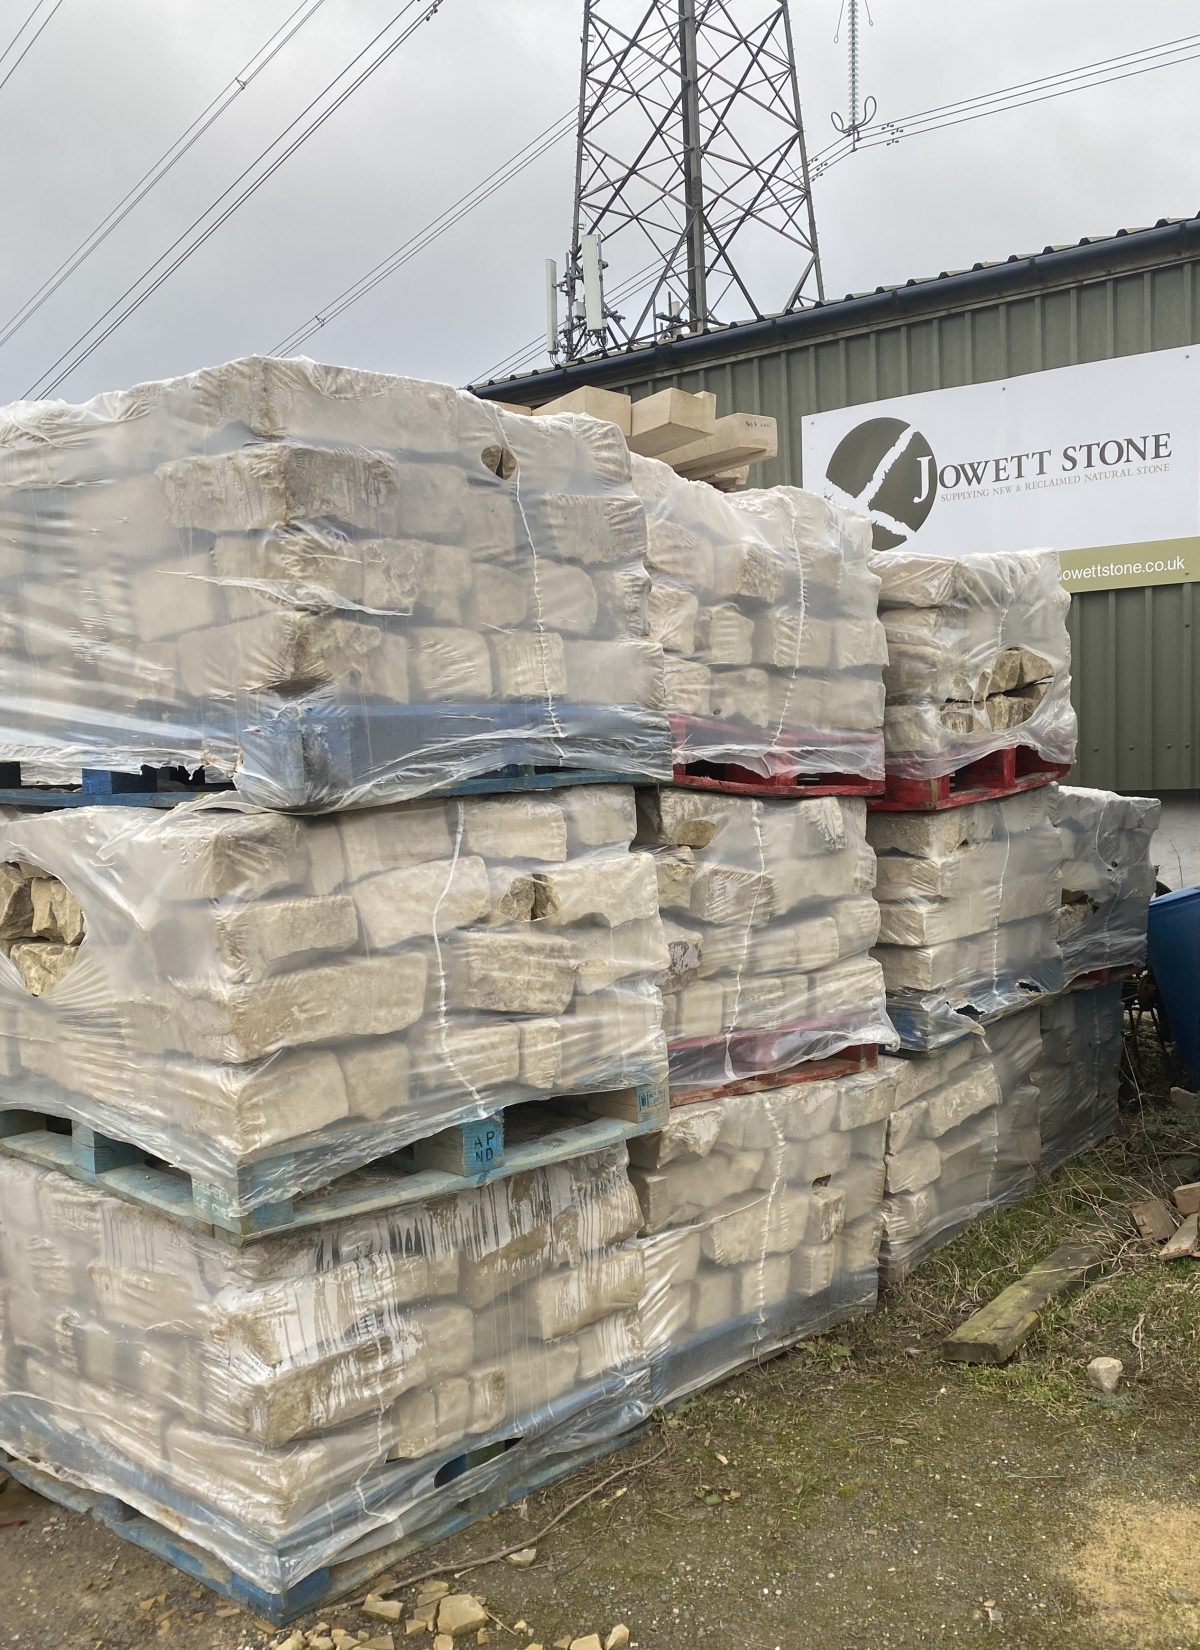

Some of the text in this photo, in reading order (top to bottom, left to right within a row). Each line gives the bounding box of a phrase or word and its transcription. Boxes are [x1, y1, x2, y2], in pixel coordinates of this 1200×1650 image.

[913, 433, 1172, 503] JOWETT STONE
[941, 488, 989, 502] SUPPLYING
[992, 485, 1013, 495] NEW
[1025, 475, 1081, 491] RECLAIMED
[1084, 469, 1134, 483] NATURAL
[1136, 463, 1170, 475] STONE
[1060, 556, 1185, 581] owettstone.co.uk
[475, 1147, 494, 1163] ND
